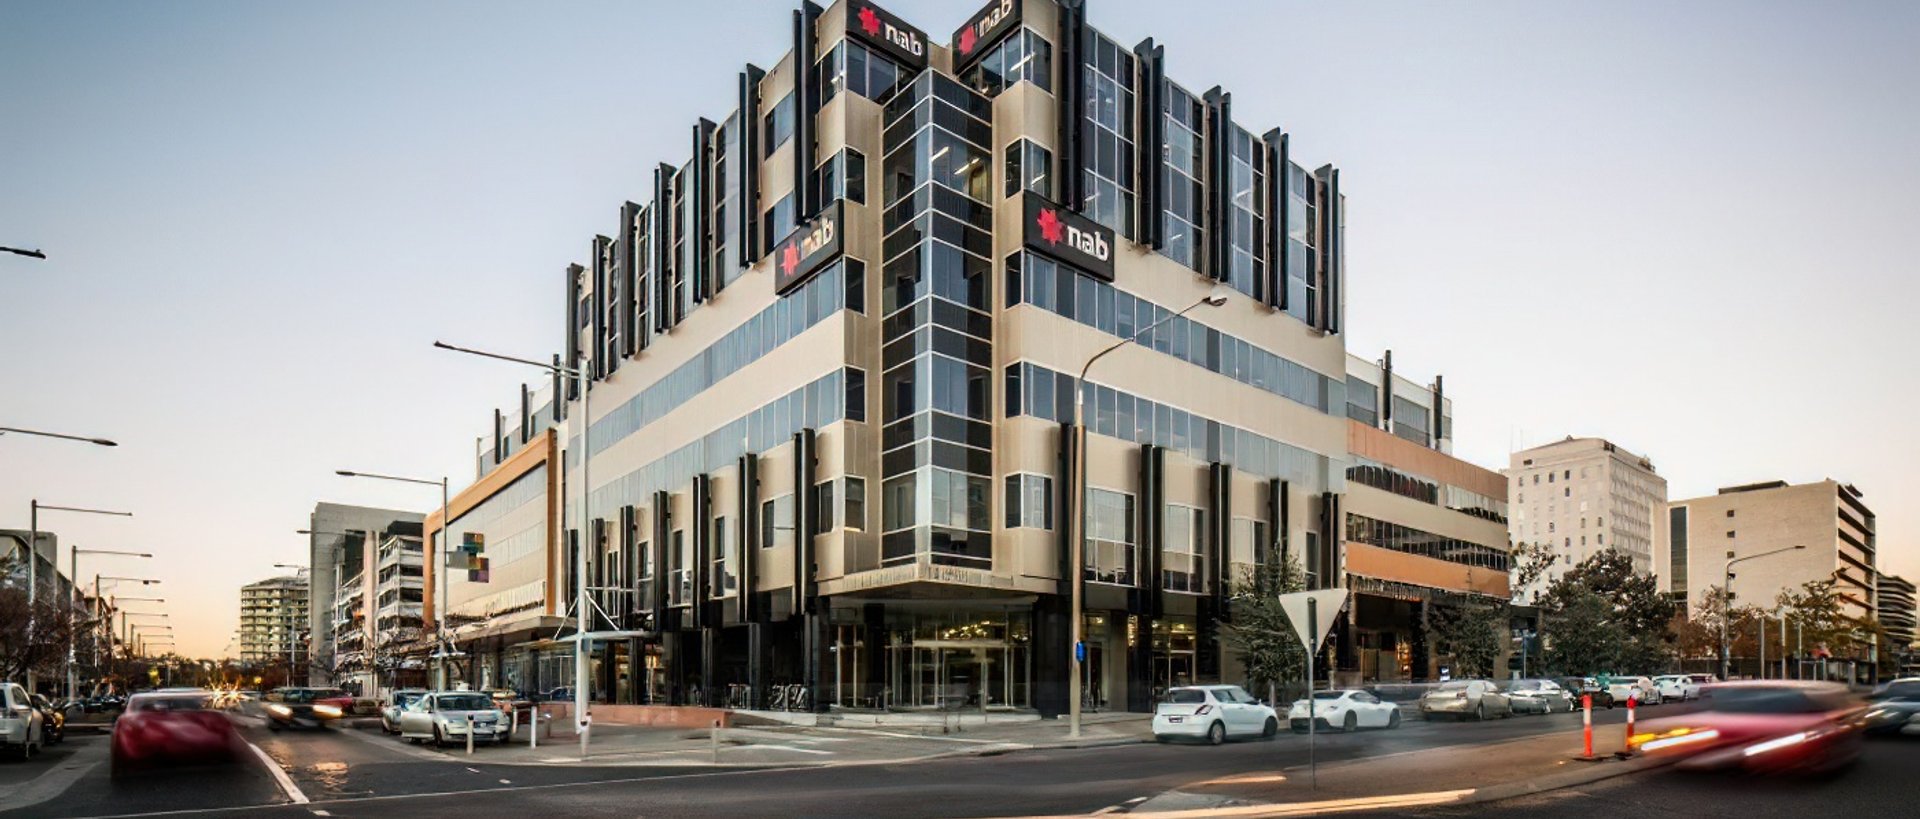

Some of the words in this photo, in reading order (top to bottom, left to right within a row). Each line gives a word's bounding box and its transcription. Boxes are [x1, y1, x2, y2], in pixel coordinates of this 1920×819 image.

[979, 0, 1012, 38] nab
[884, 22, 922, 56] nab
[800, 216, 834, 261] nab
[1067, 225, 1109, 262] nab
